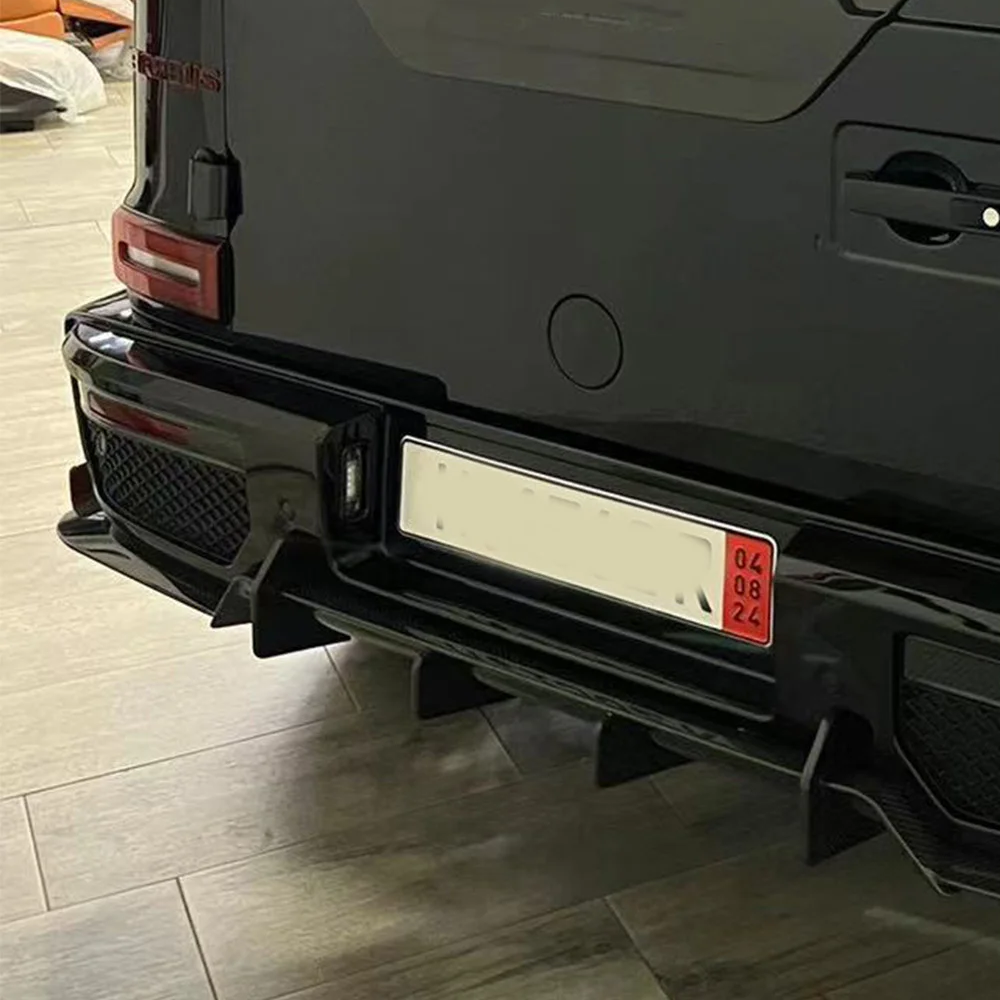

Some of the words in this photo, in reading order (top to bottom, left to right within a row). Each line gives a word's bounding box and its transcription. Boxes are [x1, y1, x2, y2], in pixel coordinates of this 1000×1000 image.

[735, 547, 763, 576] 04
[734, 574, 761, 600] 08
[732, 602, 761, 628] 24
